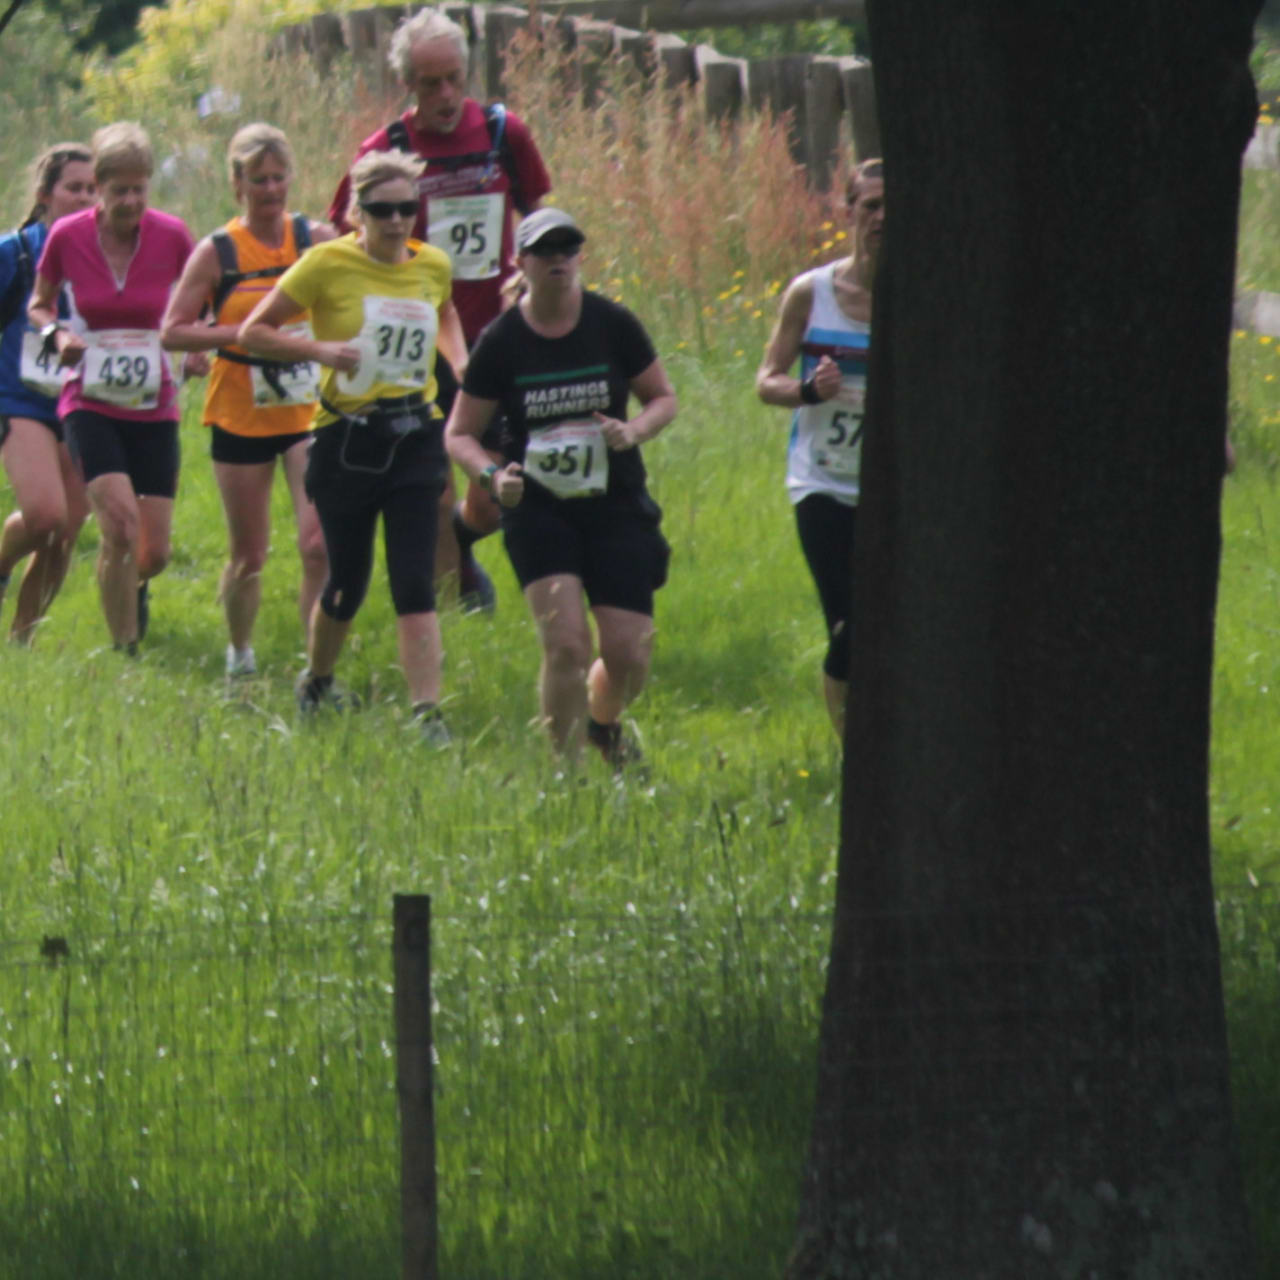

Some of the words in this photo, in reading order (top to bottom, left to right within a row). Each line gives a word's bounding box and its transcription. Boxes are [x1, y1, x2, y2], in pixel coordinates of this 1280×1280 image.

[450, 221, 487, 256] 95
[377, 325, 427, 362] 313
[99, 355, 151, 389] 439
[524, 380, 609, 405] HASTINGS
[526, 395, 610, 419] RUNNERS
[538, 444, 594, 479] 351
